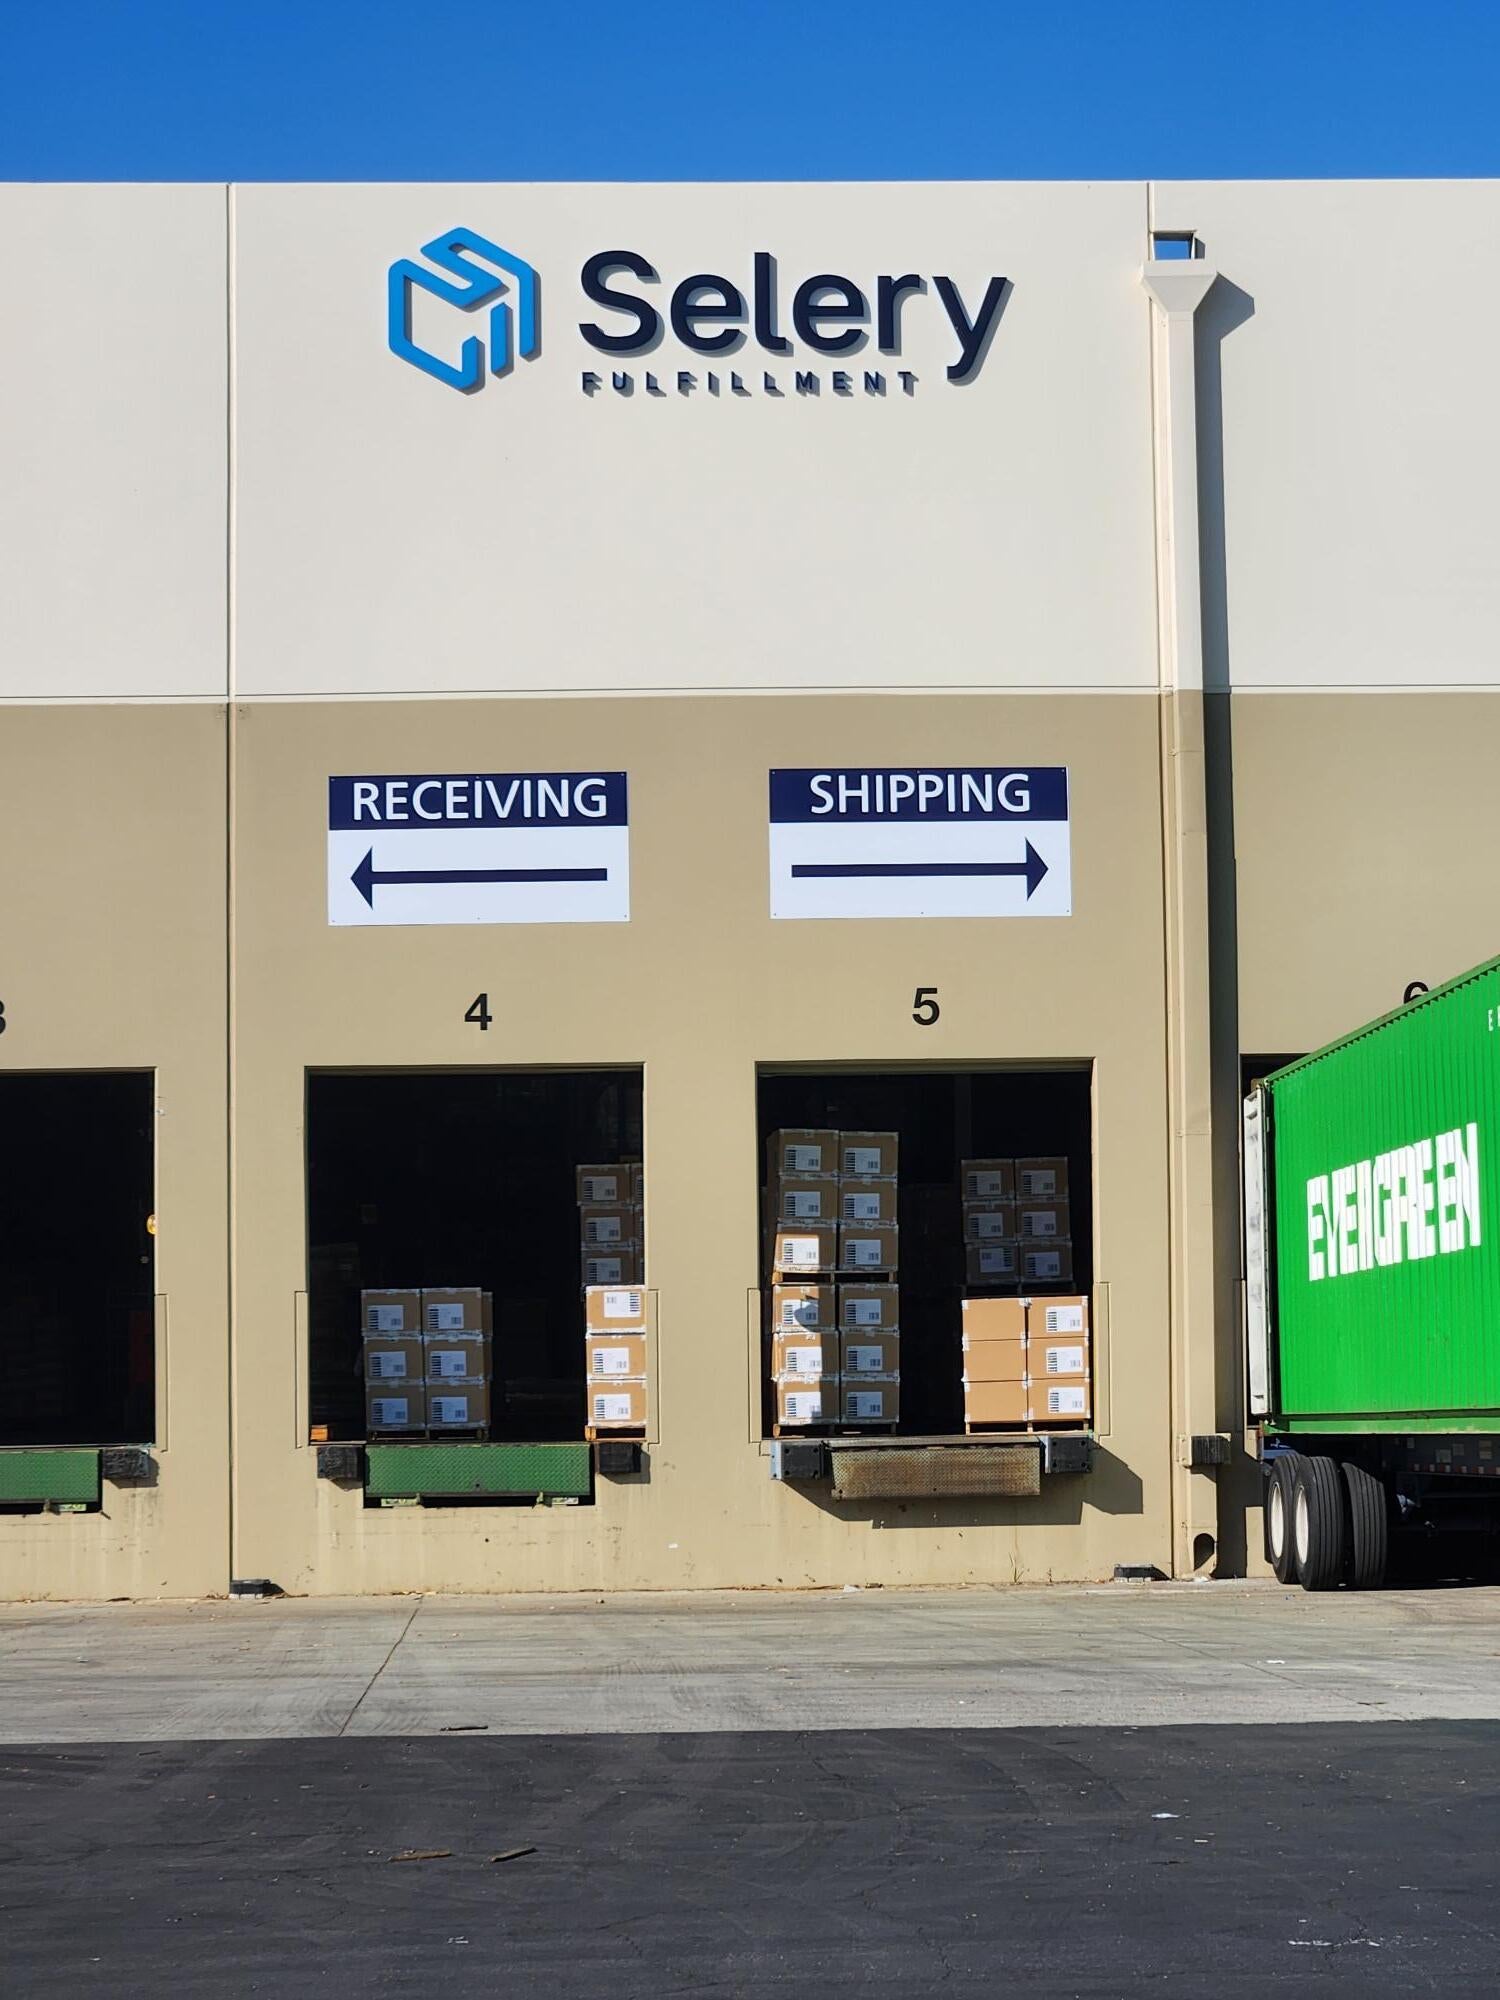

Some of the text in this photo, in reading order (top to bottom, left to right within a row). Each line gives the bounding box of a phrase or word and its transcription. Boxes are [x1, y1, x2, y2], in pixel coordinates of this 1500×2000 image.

[579, 250, 1008, 379] Selery
[581, 371, 914, 391] FULFILLMENT
[352, 778, 608, 822] RECEIVING
[809, 772, 1031, 815] SHIPPING
[464, 993, 493, 1031] 4
[912, 988, 940, 1026] 5
[1307, 1122, 1482, 1281] EVERGREEN
